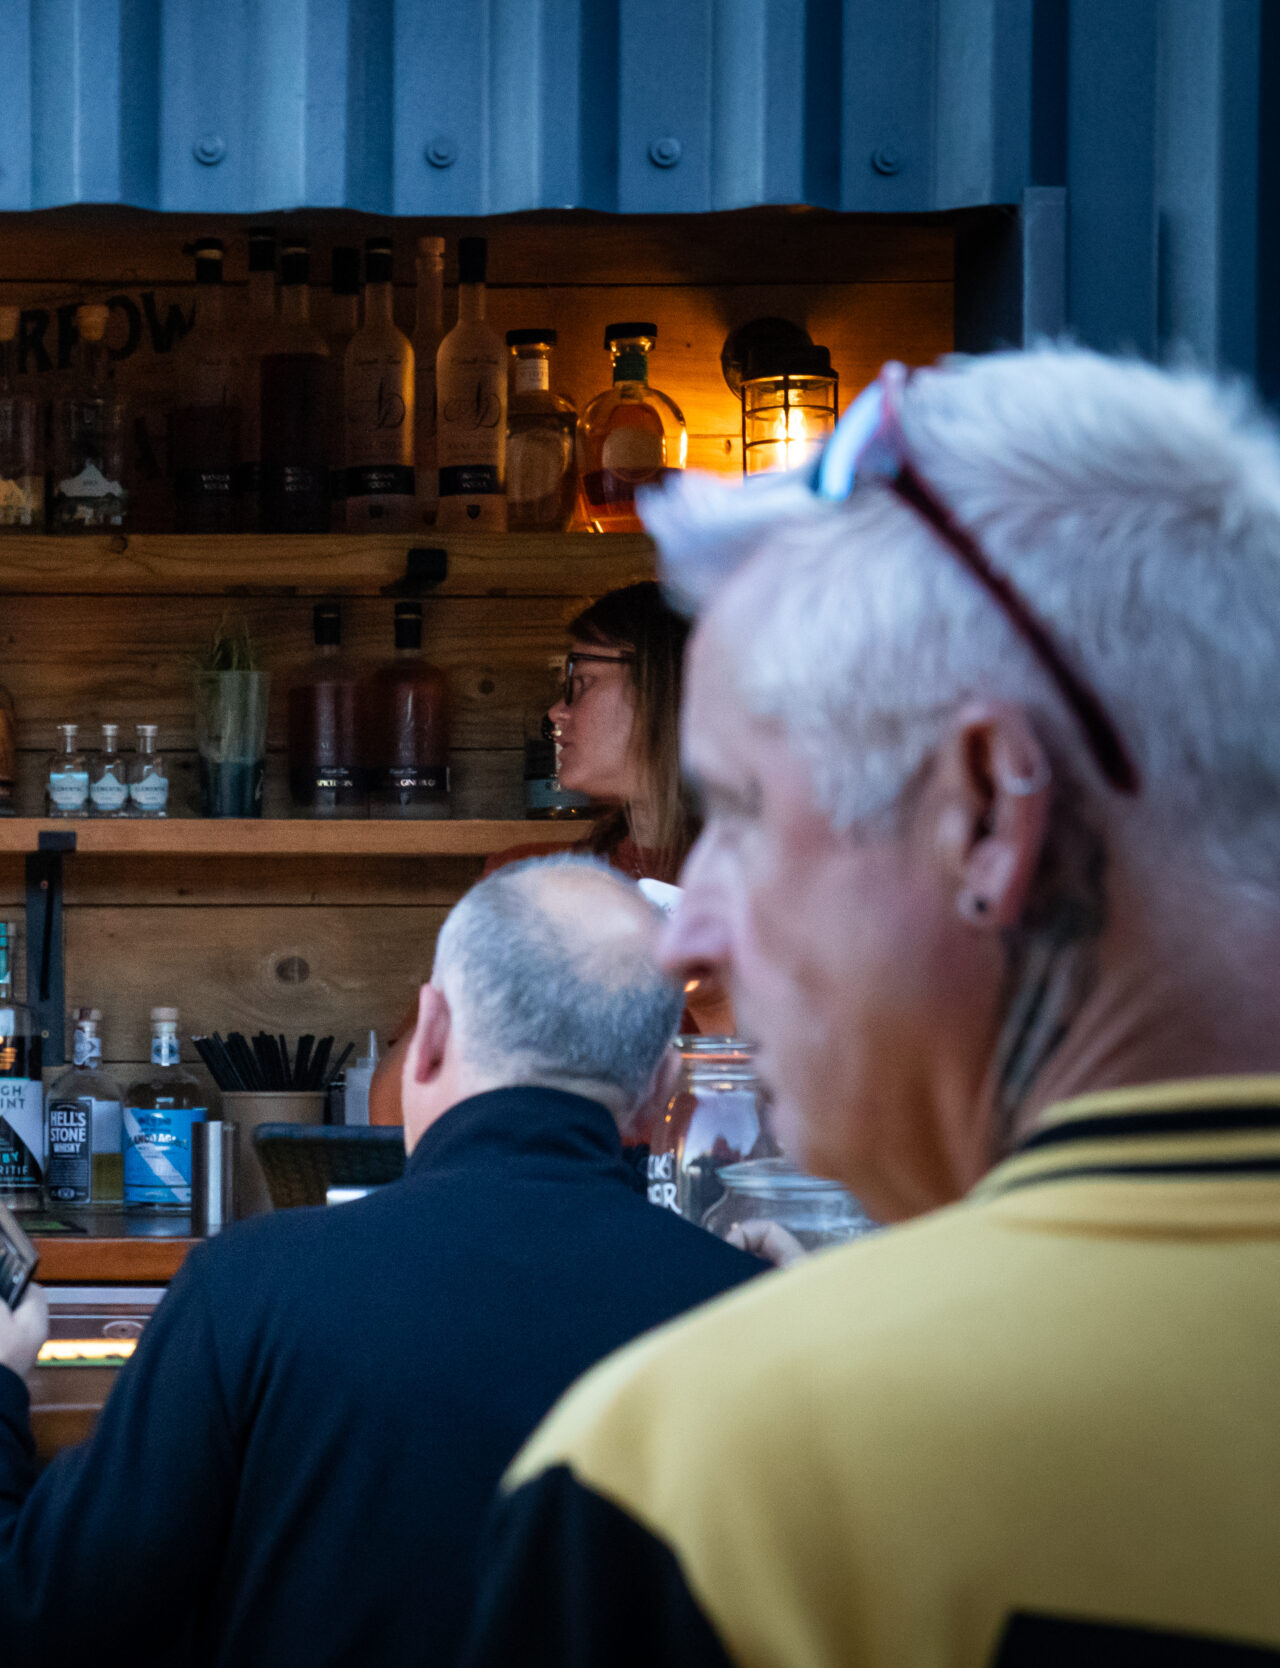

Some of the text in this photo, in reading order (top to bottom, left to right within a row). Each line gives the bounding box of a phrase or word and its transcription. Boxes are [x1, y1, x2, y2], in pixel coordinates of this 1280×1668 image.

[49, 1110, 87, 1127] HELL'S
[49, 1127, 87, 1143] STONE
[52, 1142, 81, 1154] WHISKY
